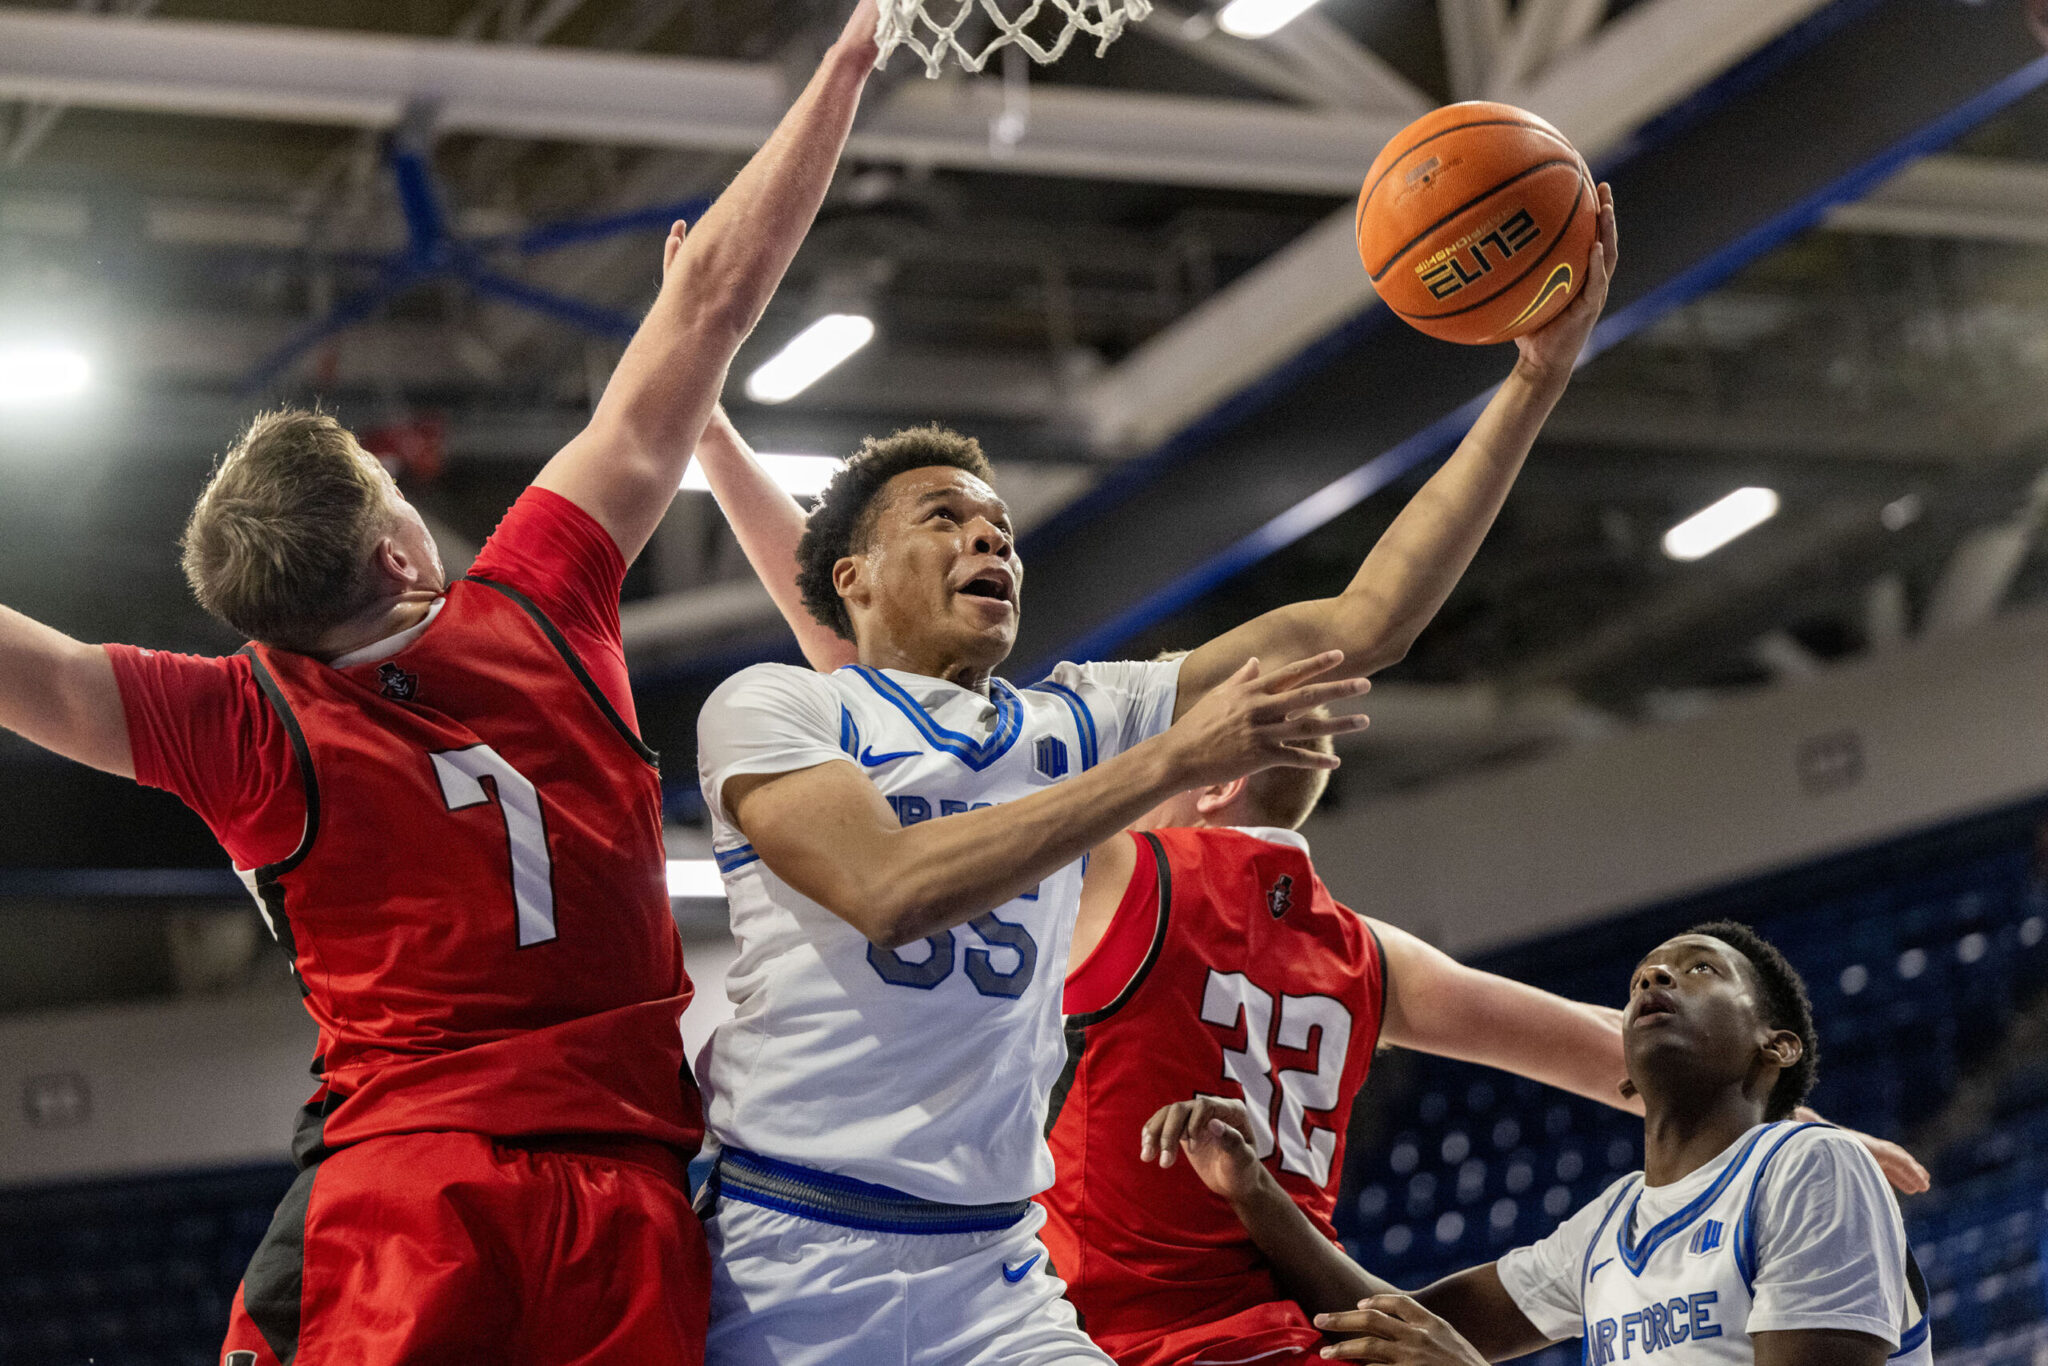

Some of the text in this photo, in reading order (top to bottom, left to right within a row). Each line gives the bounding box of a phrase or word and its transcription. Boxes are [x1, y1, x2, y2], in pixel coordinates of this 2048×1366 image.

[1414, 205, 1524, 274] MPIONSHIP
[1419, 207, 1542, 301] ELITE
[428, 742, 558, 950] 7
[1195, 966, 1352, 1189] 32
[1621, 1290, 1723, 1360] FORCE
